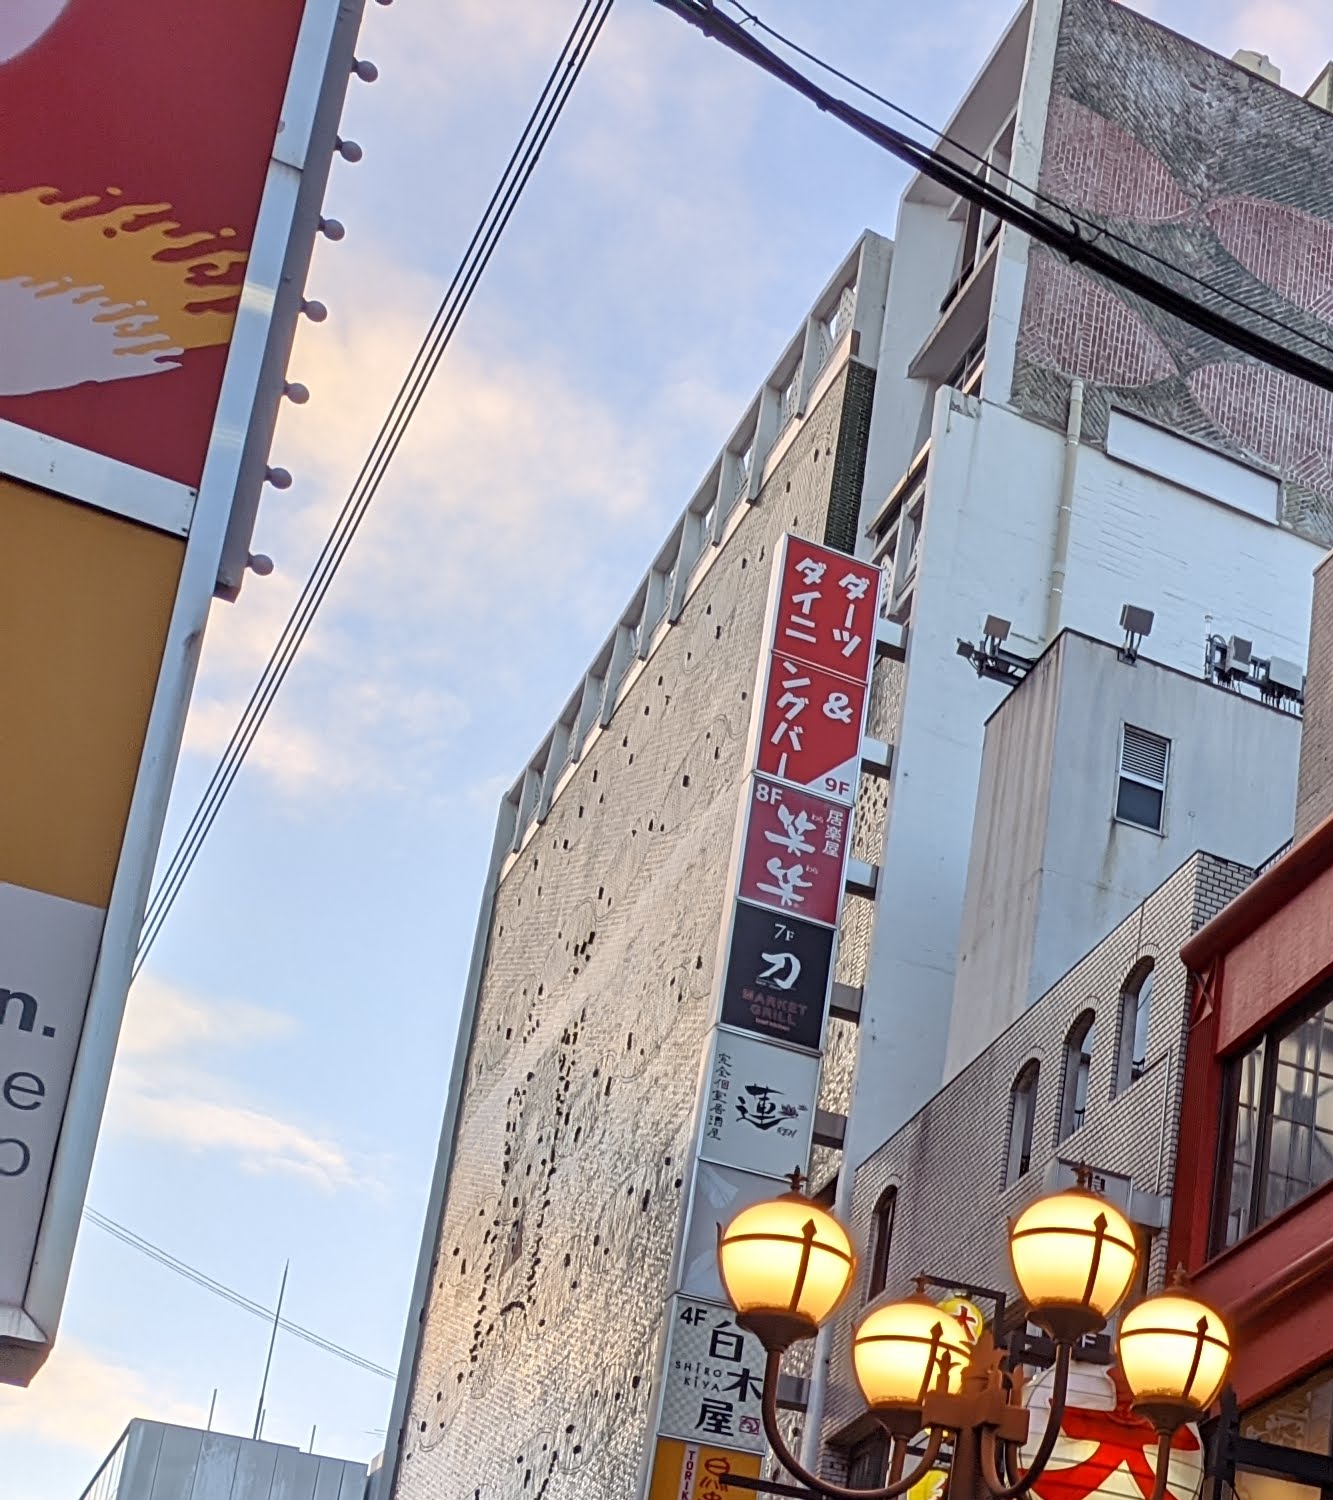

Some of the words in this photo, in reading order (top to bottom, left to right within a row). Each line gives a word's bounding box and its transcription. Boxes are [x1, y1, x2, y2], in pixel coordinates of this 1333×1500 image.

[833, 572, 870, 658] ダーツ
[770, 556, 829, 779] ダイニングバー
[755, 783, 782, 804] 8F
[824, 777, 850, 797] 9F
[774, 923, 795, 942] 7F
[758, 951, 801, 990] 刀
[750, 1003, 796, 1027] GRILL
[707, 1052, 733, 1141] 完全個室居酒屋
[680, 1307, 707, 1327] 4F
[696, 1321, 764, 1437] 白木屋
